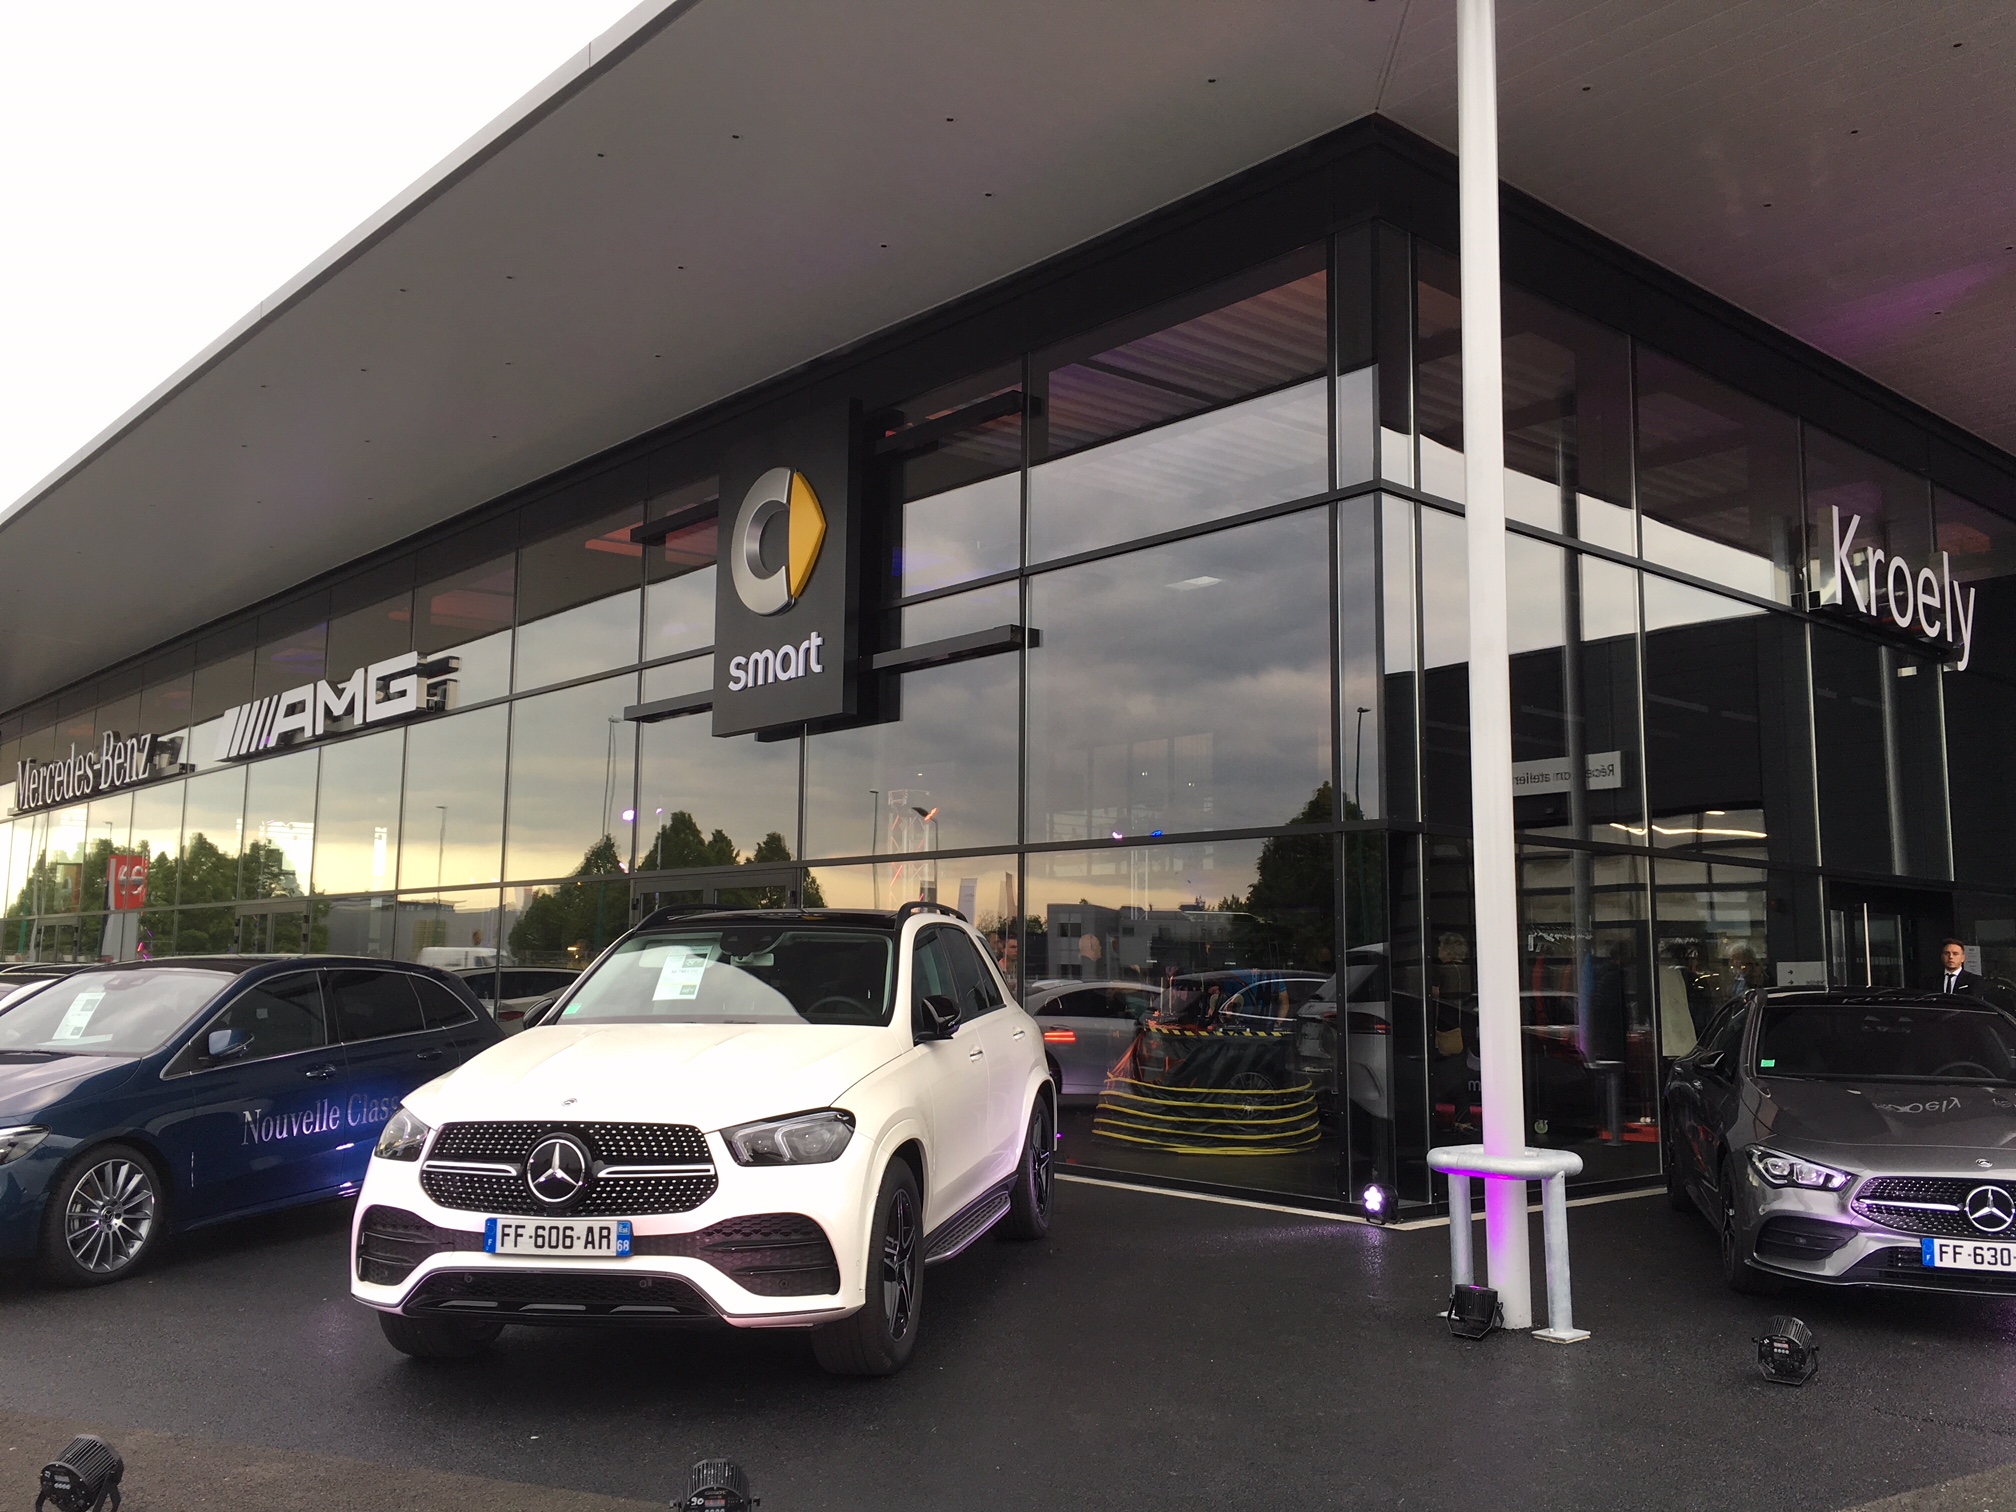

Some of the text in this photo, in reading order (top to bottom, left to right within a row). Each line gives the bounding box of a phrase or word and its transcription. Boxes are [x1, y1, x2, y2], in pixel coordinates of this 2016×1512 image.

[1831, 505, 1975, 671] Kroely
[728, 631, 825, 692] smart
[14, 730, 152, 811] Mercedes-Benz
[241, 1098, 340, 1146] Nouvelle
[500, 1224, 611, 1250] FF-606-AR
[617, 1239, 630, 1252] 68
